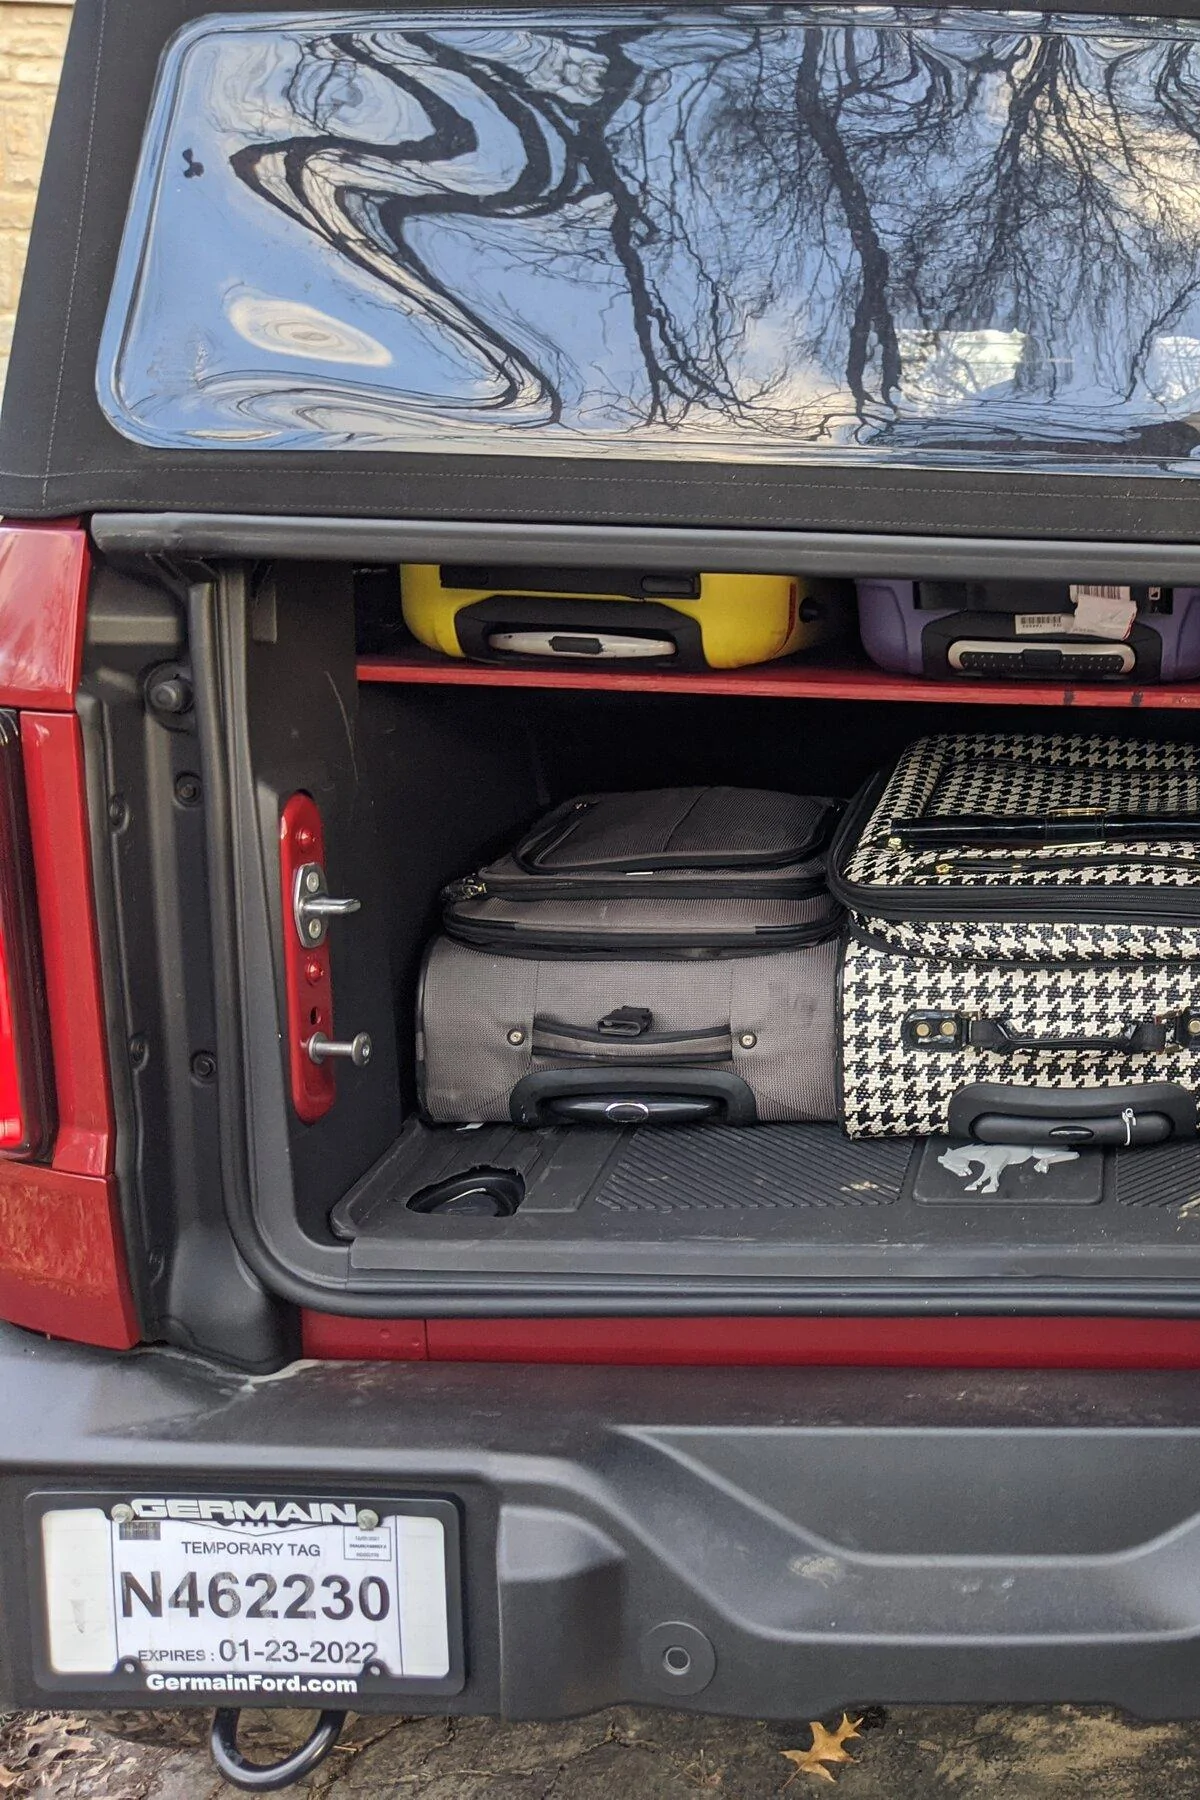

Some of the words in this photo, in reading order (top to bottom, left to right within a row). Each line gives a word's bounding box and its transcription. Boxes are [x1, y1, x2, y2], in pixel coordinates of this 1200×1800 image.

[131, 1498, 357, 1524] GERMAIN
[181, 1541, 284, 1557] TEMPORARY
[287, 1543, 321, 1557] TAG
[120, 1570, 391, 1622] N462230
[218, 1639, 379, 1664] 01-23-2022
[146, 1673, 358, 1693] GermainFord.com
